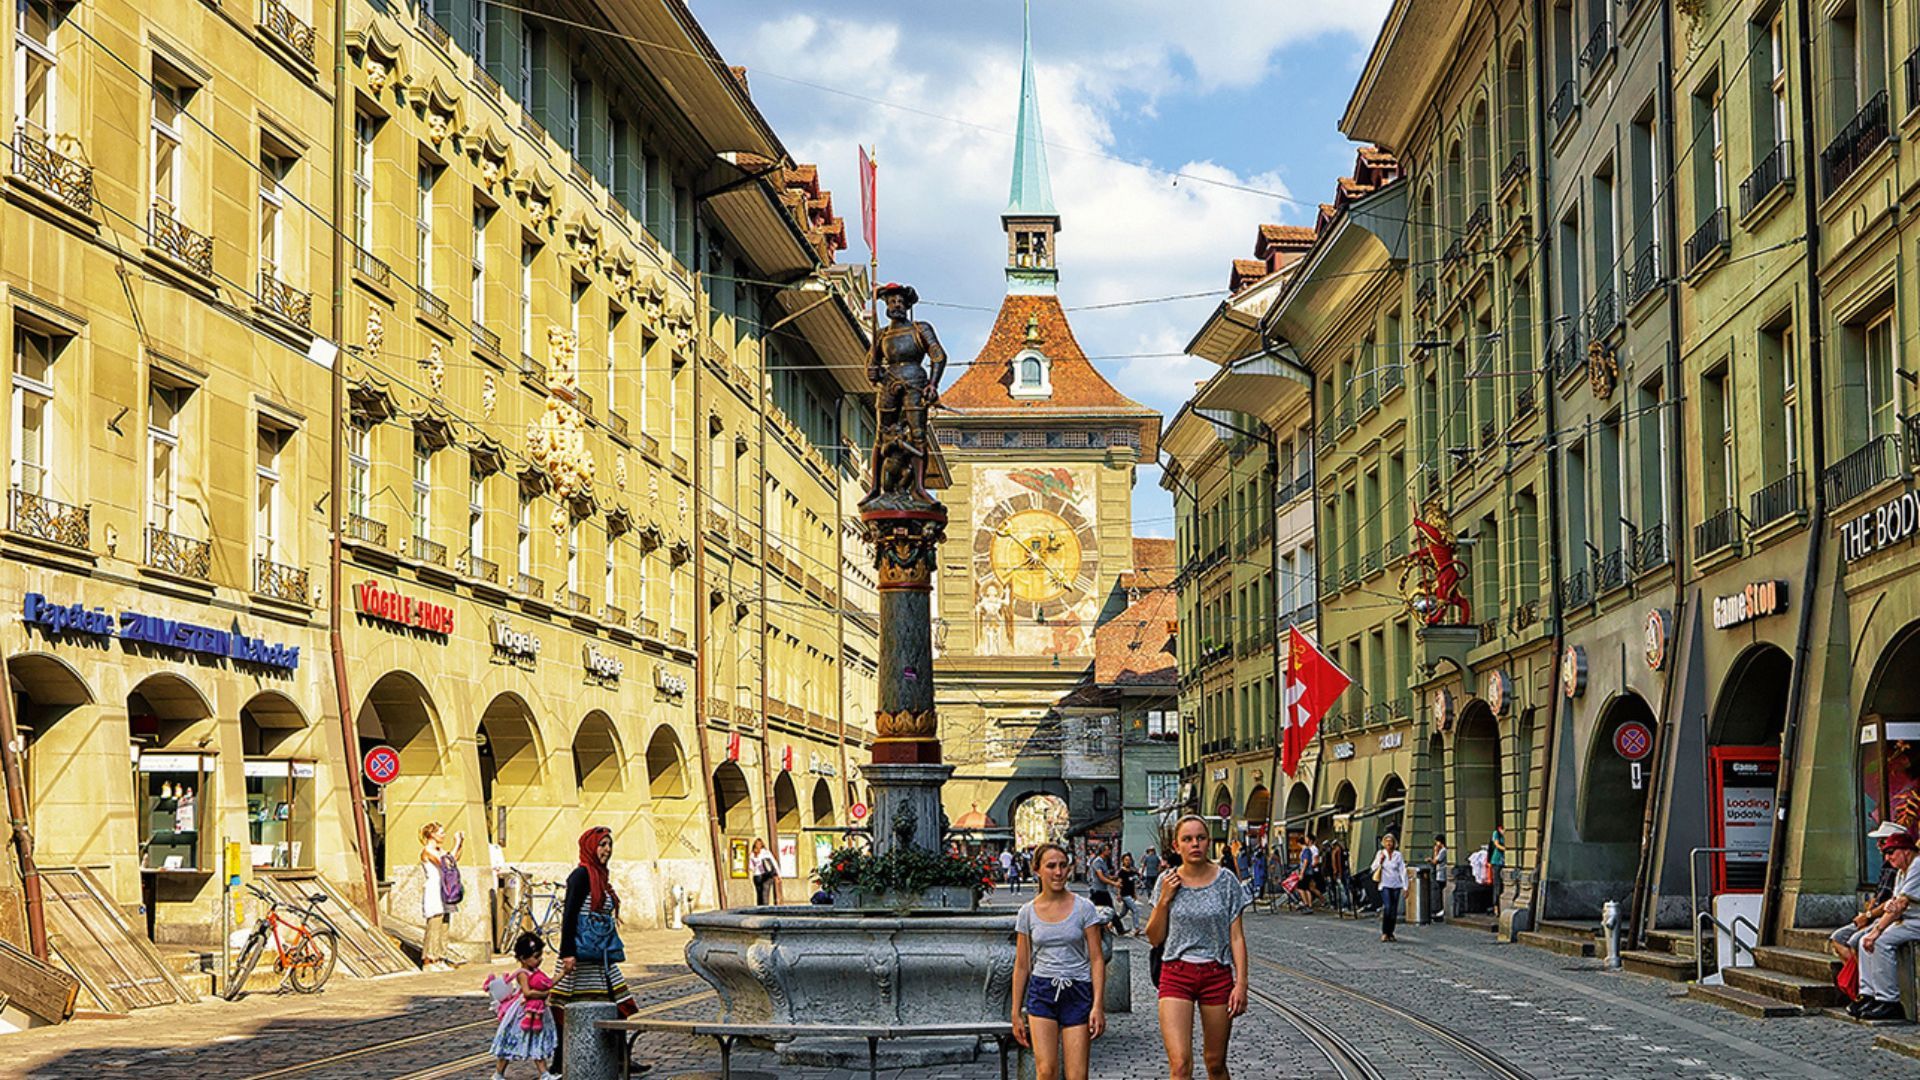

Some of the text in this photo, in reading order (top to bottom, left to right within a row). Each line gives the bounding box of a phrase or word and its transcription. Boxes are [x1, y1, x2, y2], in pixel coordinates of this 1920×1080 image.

[1840, 513, 1872, 561] THE
[23, 592, 115, 633] Papeterie
[120, 612, 233, 656] ZUMSTEIN
[360, 580, 455, 635] VÖGELE SHOES
[1713, 580, 1777, 629] GameStop
[1726, 798, 1770, 811] Loading
